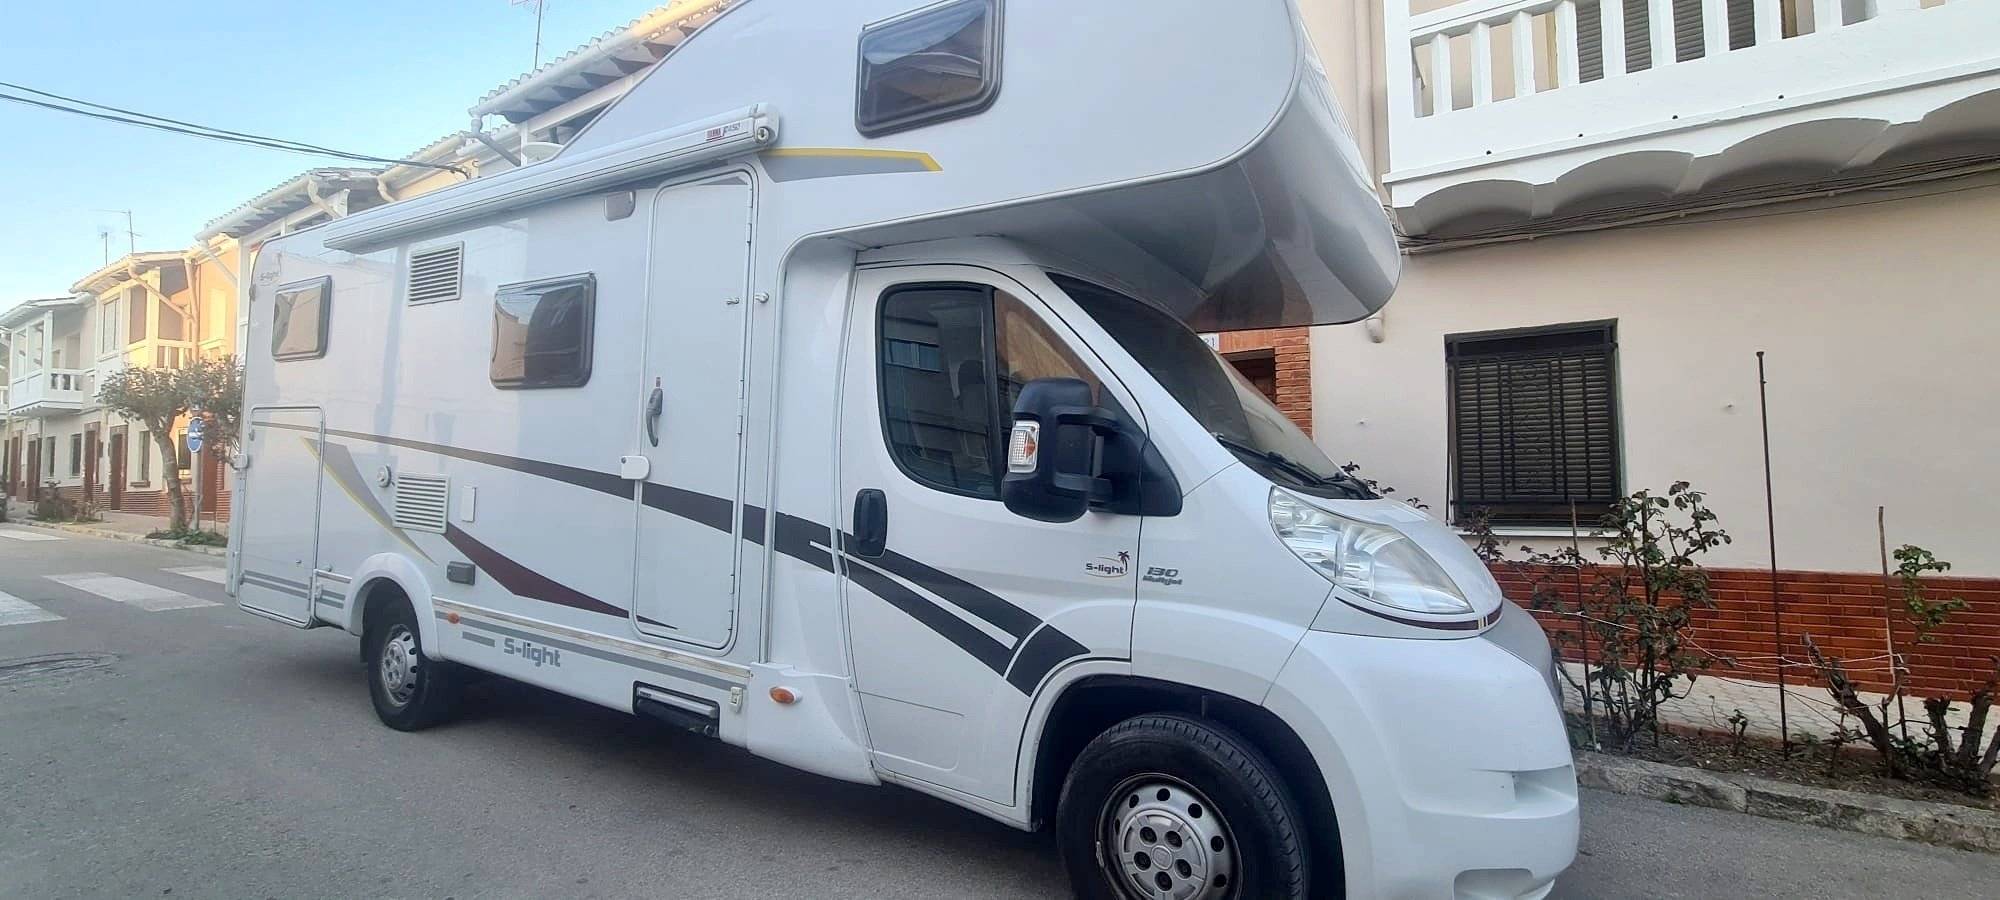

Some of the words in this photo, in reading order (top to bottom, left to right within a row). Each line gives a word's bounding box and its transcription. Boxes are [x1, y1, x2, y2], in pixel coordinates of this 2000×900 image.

[1085, 562, 1124, 574] S-light
[1146, 566, 1178, 577] 130
[503, 637, 561, 667] S-light
